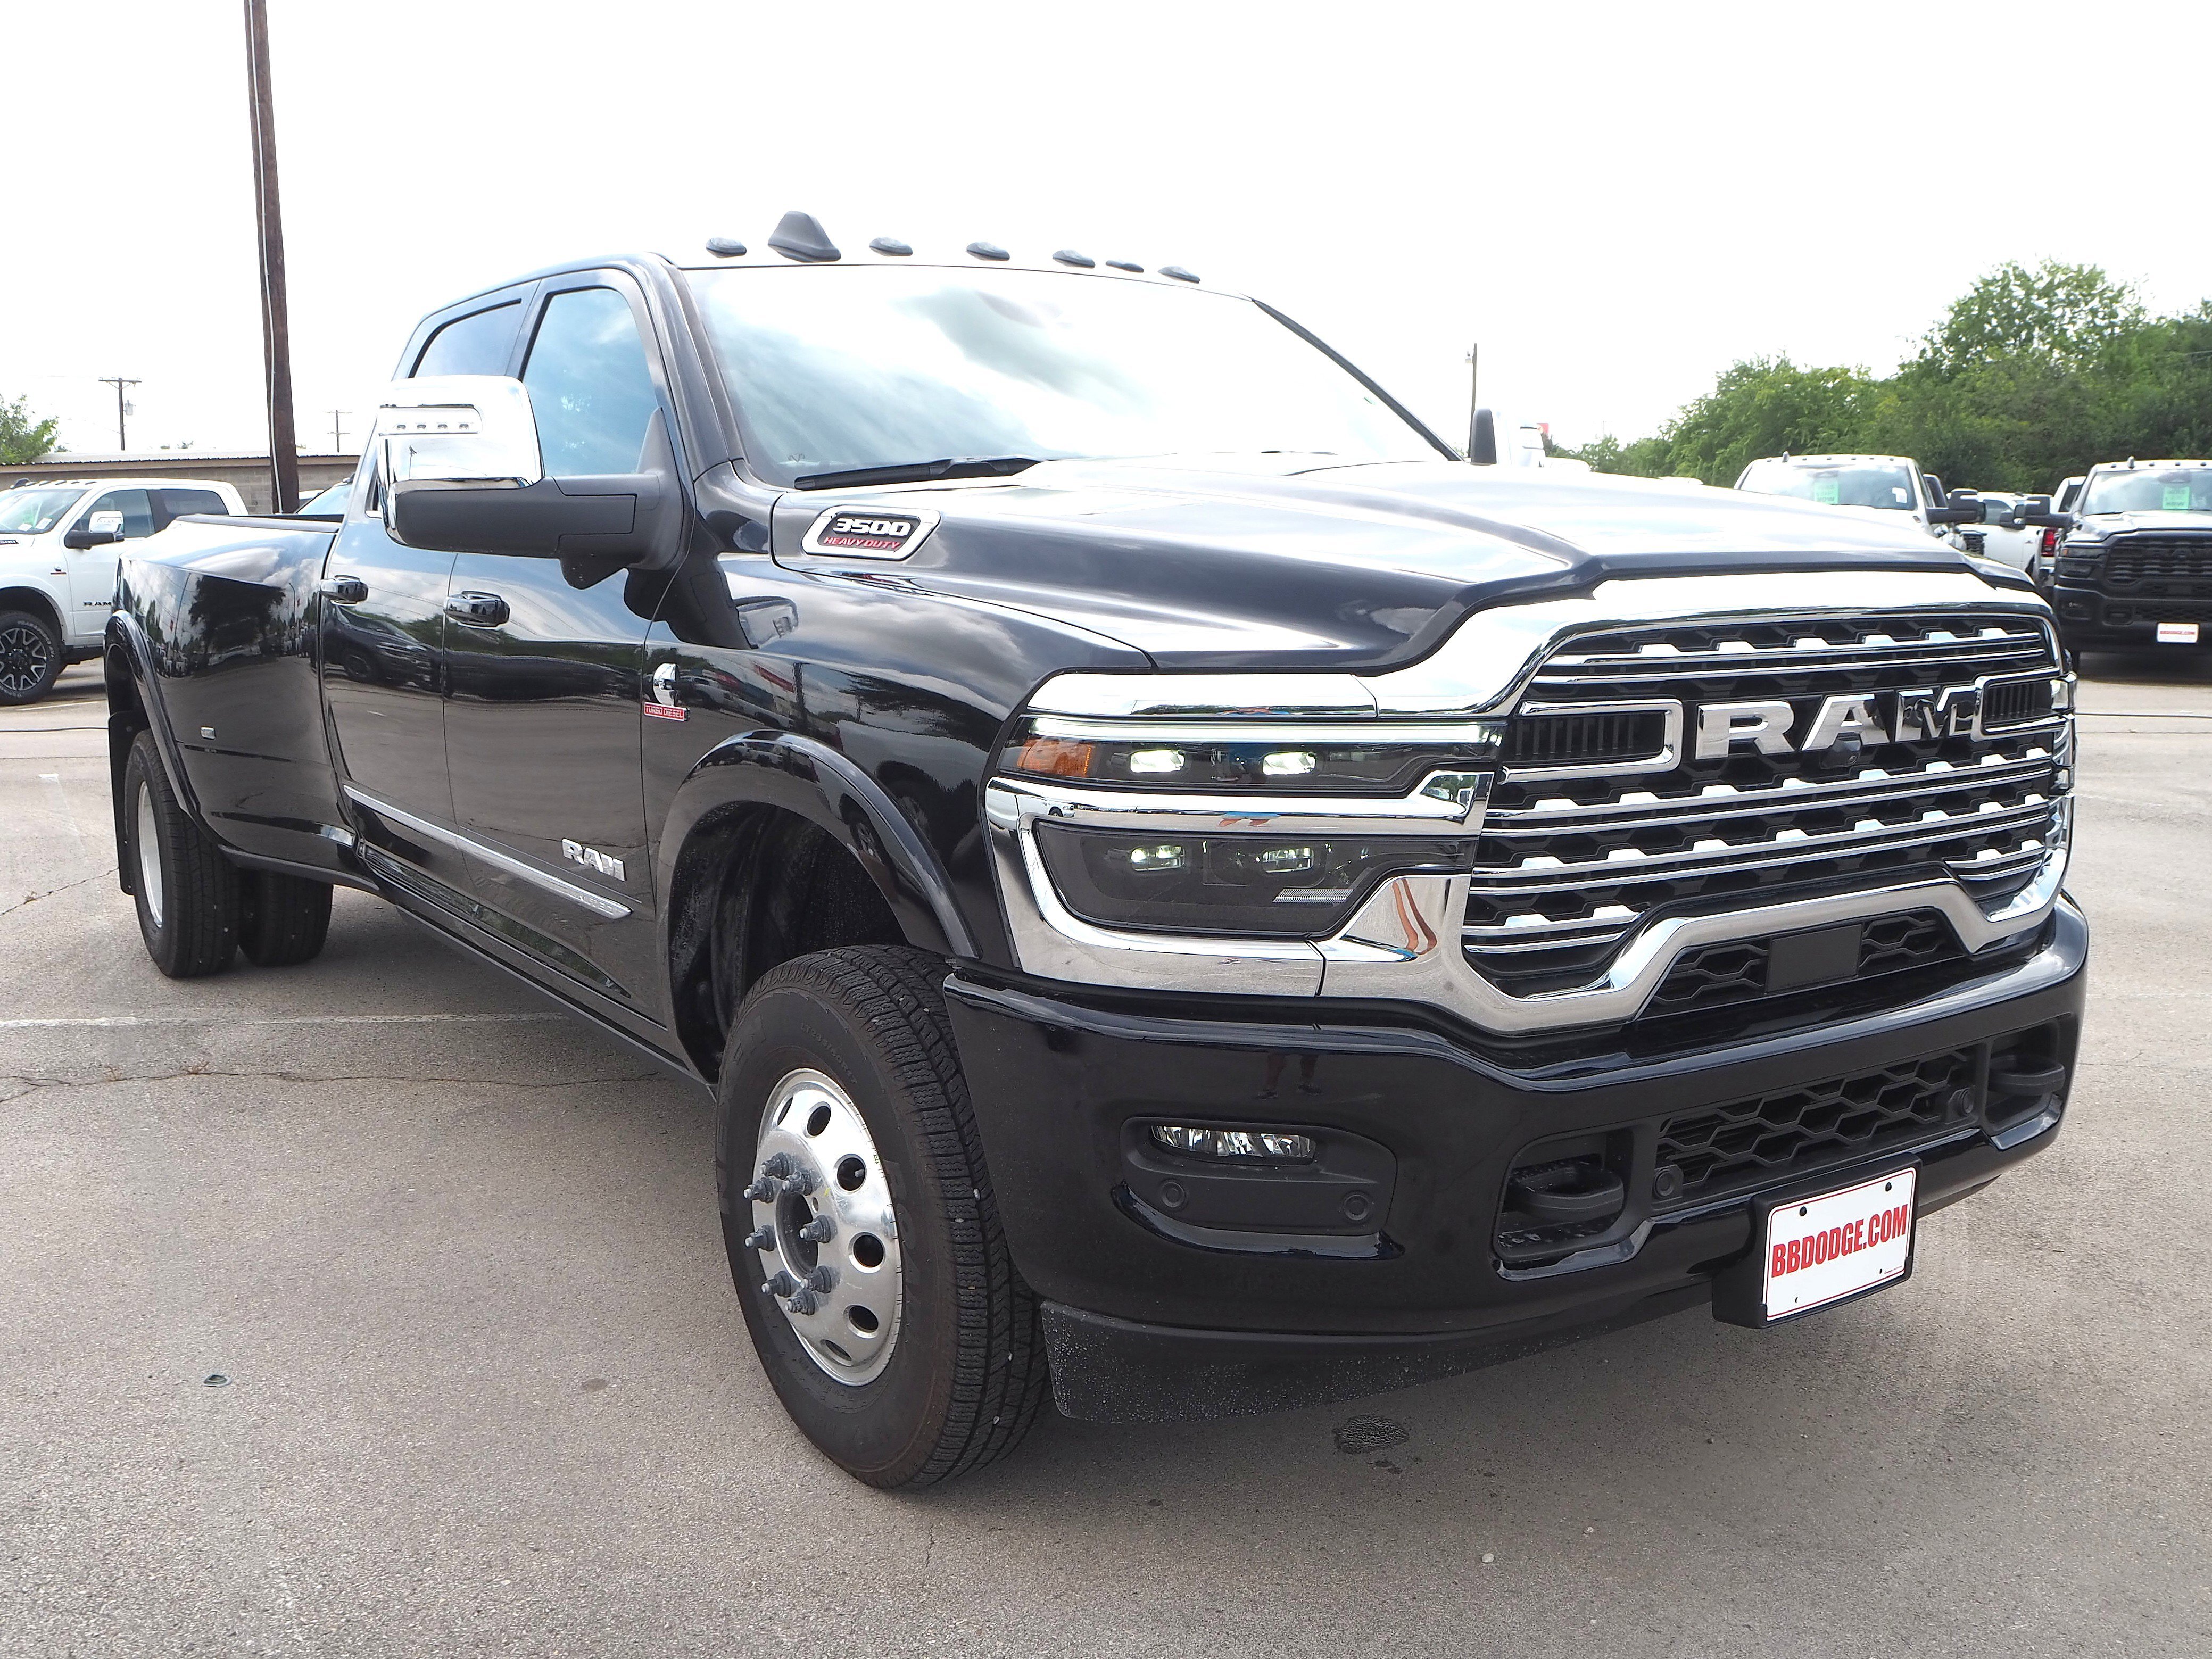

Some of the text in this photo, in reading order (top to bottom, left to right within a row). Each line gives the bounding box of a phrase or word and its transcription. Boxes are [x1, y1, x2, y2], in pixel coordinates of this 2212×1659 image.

[832, 518, 912, 536] 3500
[823, 537, 900, 549] HEAVY DUTY
[645, 705, 683, 718] TURBO DIESEL
[1696, 685, 1976, 759] RAM
[562, 838, 627, 882] RAM
[1771, 1204, 1908, 1278] BBDODGE.COM
